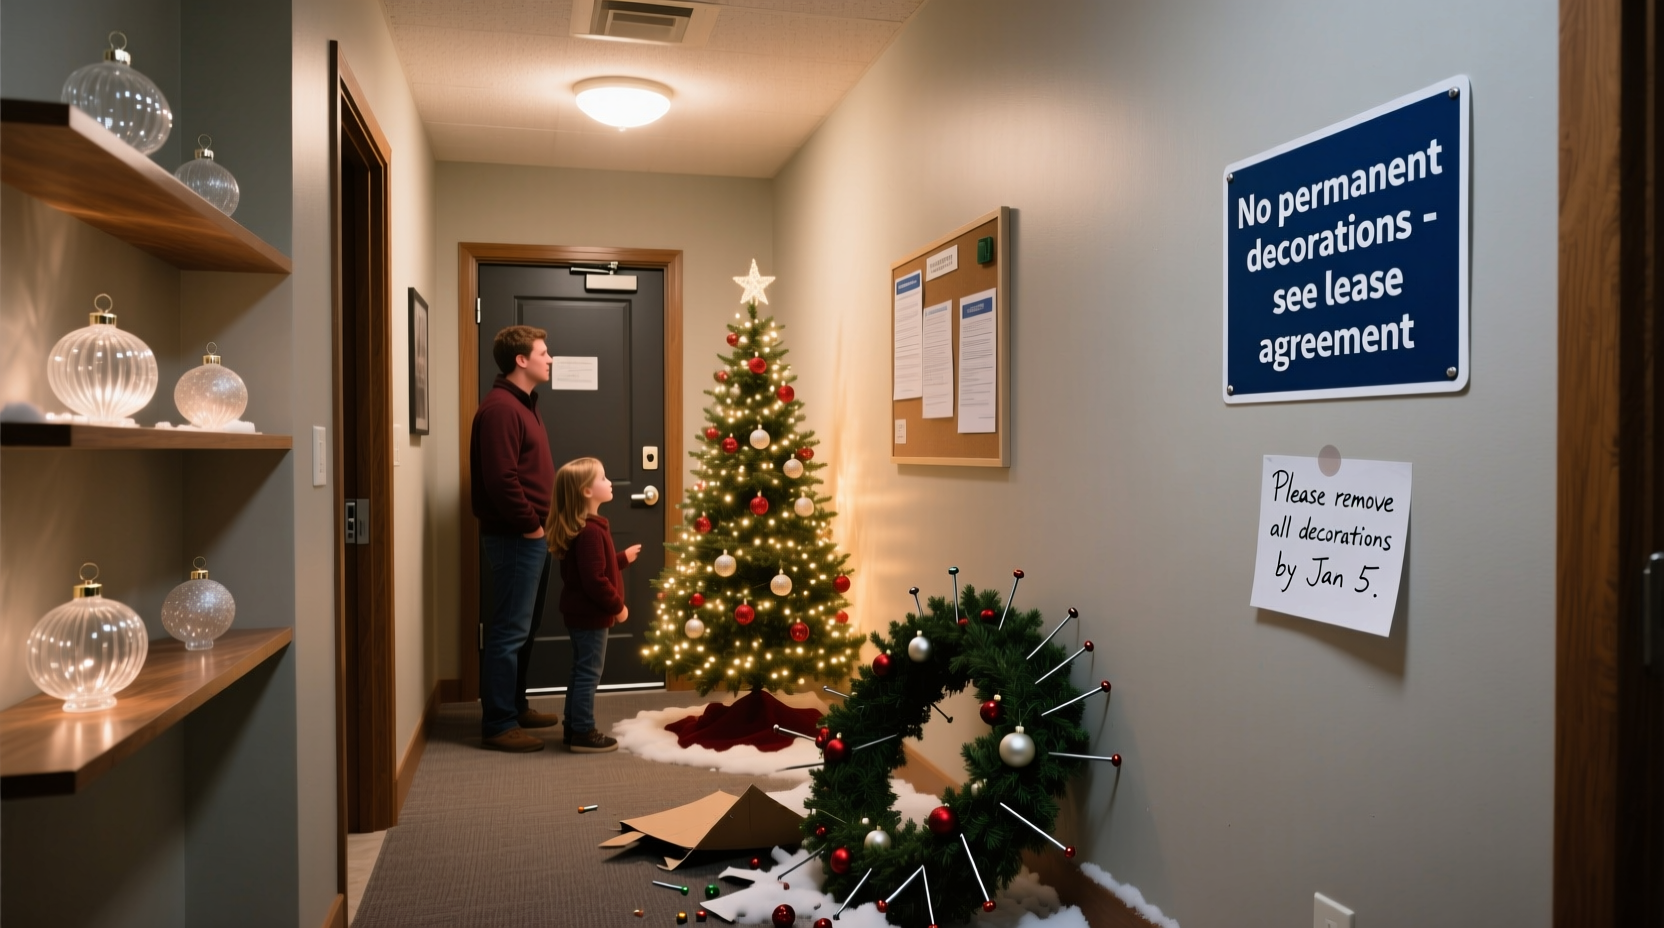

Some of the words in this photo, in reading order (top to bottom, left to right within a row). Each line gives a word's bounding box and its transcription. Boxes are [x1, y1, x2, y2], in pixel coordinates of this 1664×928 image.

[1238, 194, 1271, 229] No
[1278, 138, 1443, 228] permanent
[1247, 210, 1412, 272] decorations
[1272, 283, 1318, 315] see
[1325, 266, 1404, 306] lease
[1259, 313, 1415, 372] agreement
[1272, 469, 1326, 506] Please
[1334, 491, 1394, 513] remove
[1270, 514, 1292, 539] all
[1298, 516, 1392, 551] decorations
[1275, 550, 1297, 593] by
[1306, 557, 1344, 588] Jan
[1354, 565, 1380, 598] 5.
